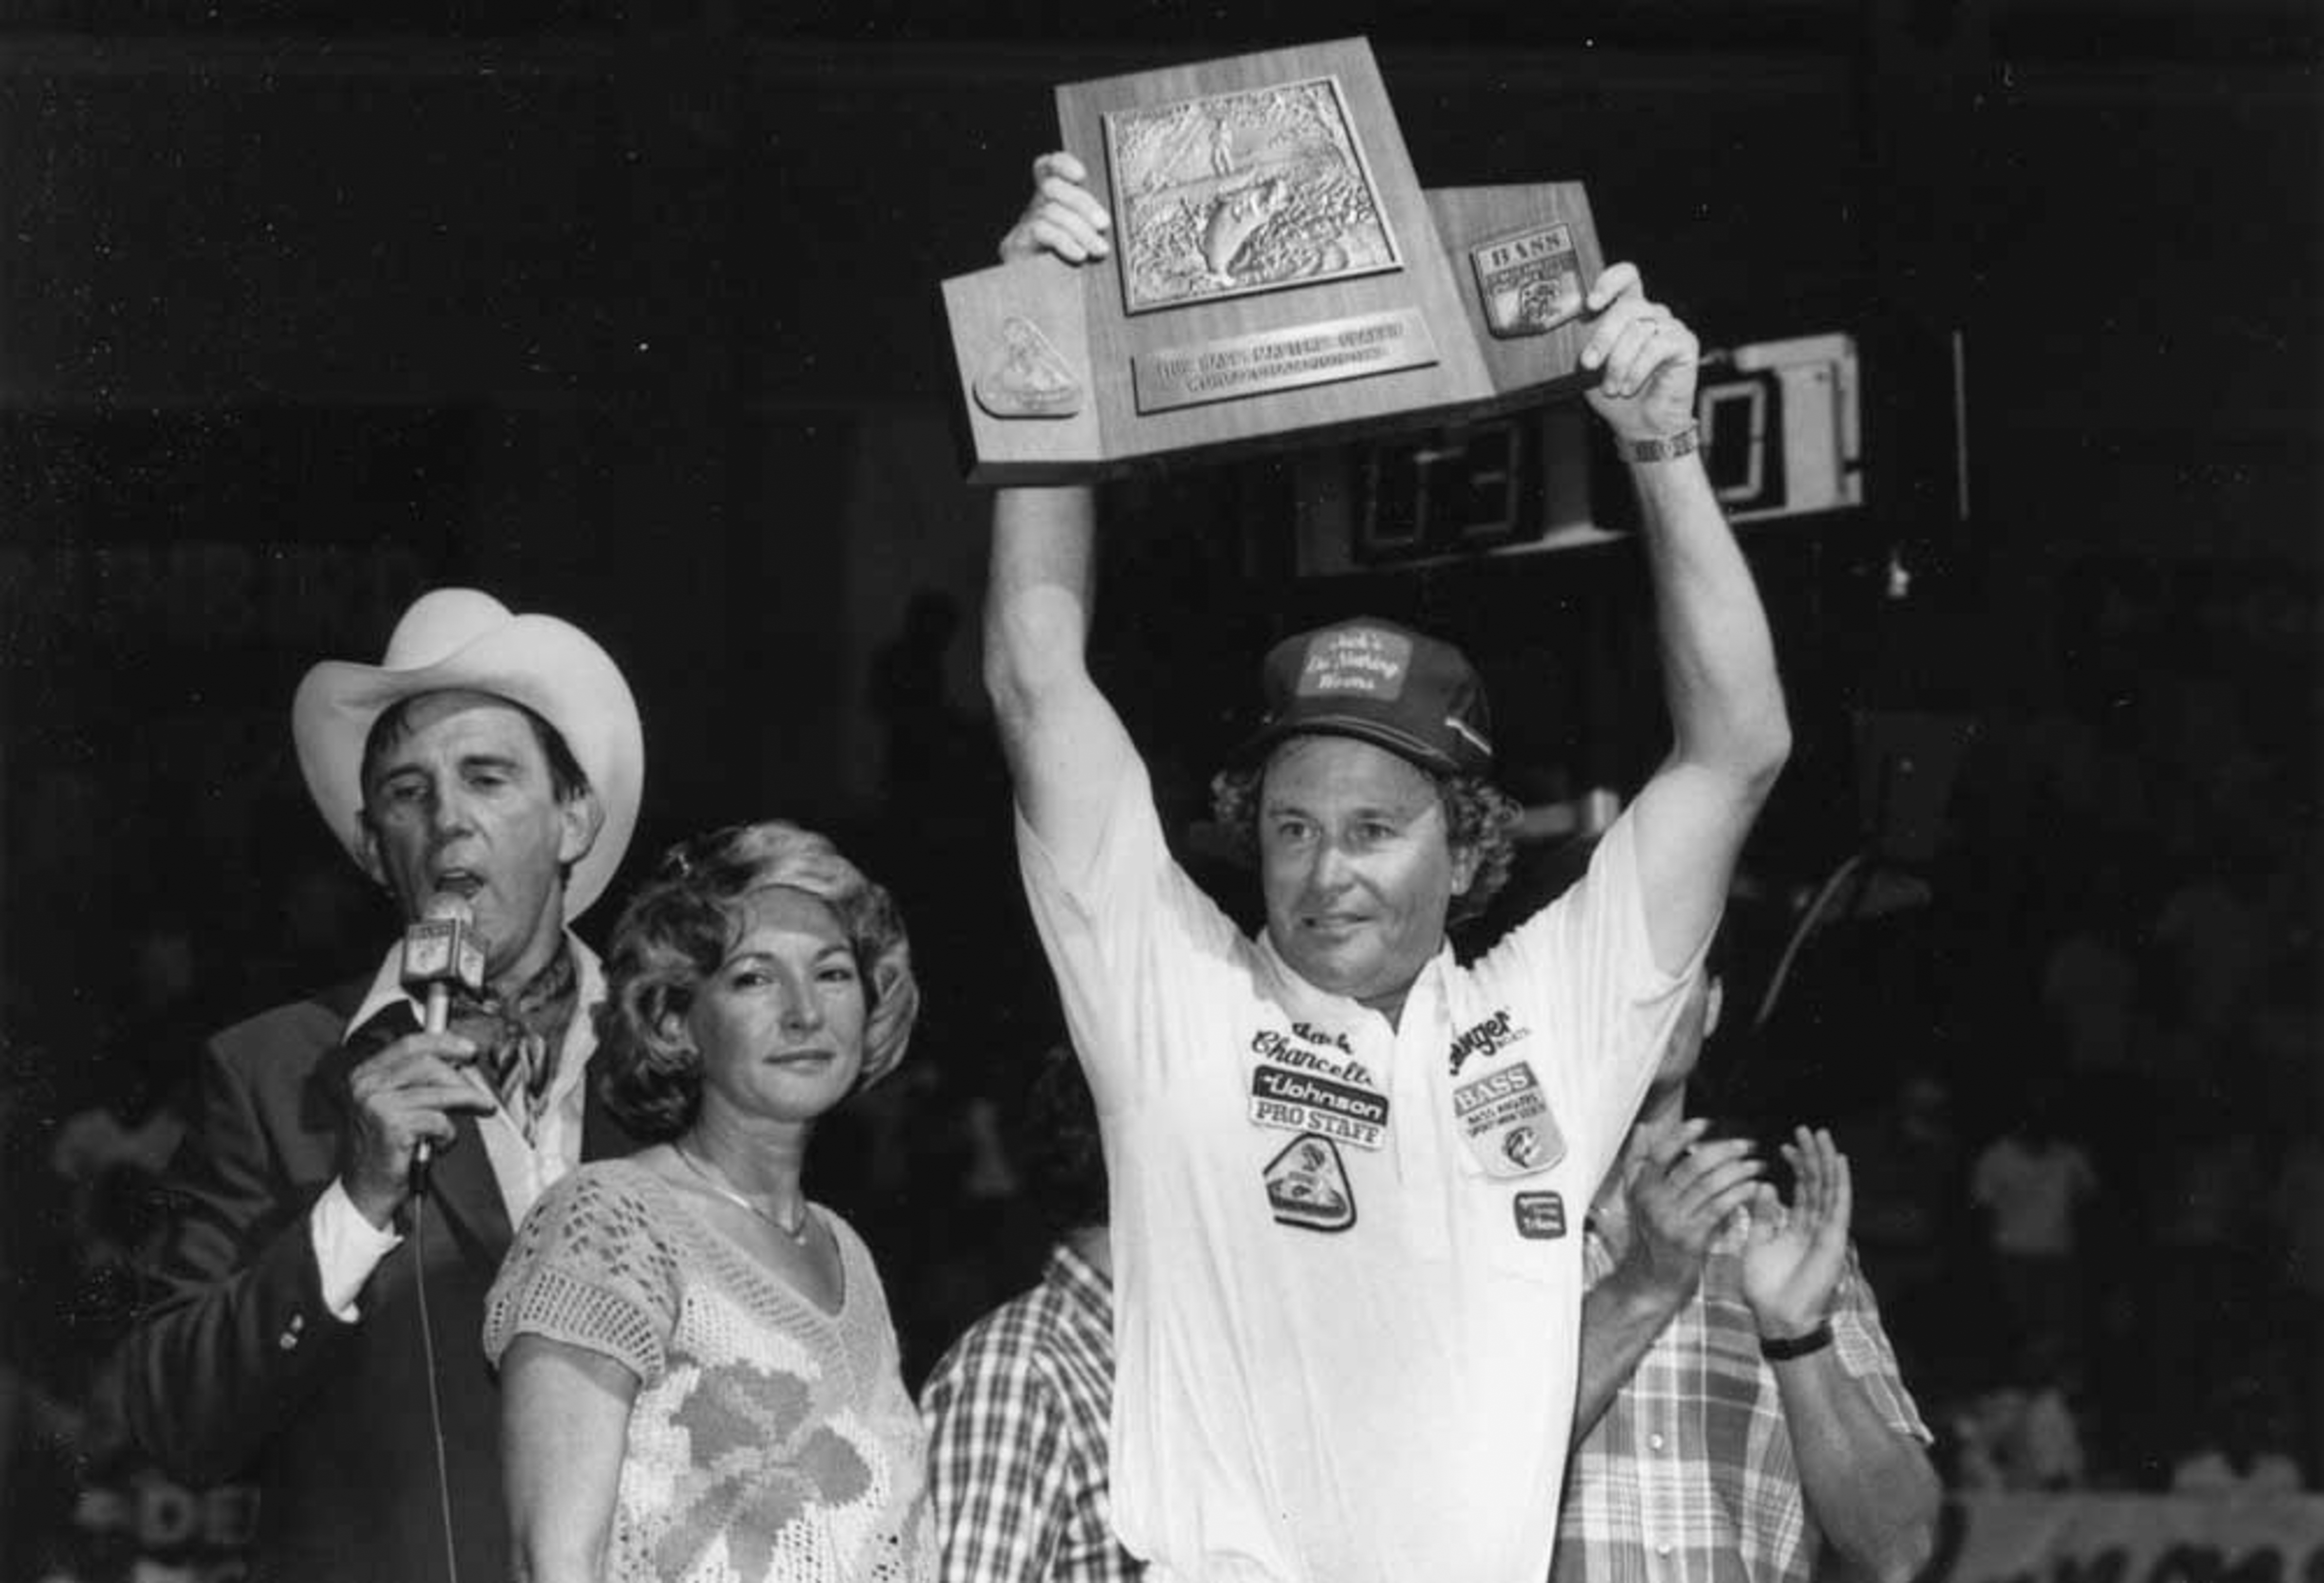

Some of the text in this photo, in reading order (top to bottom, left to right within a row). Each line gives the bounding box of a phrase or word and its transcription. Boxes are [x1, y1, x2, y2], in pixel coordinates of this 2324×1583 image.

[1269, 1072, 1382, 1120] Johnson
[1454, 1066, 1529, 1110] BASS
[1257, 1101, 1379, 1143] PRO STAFF
